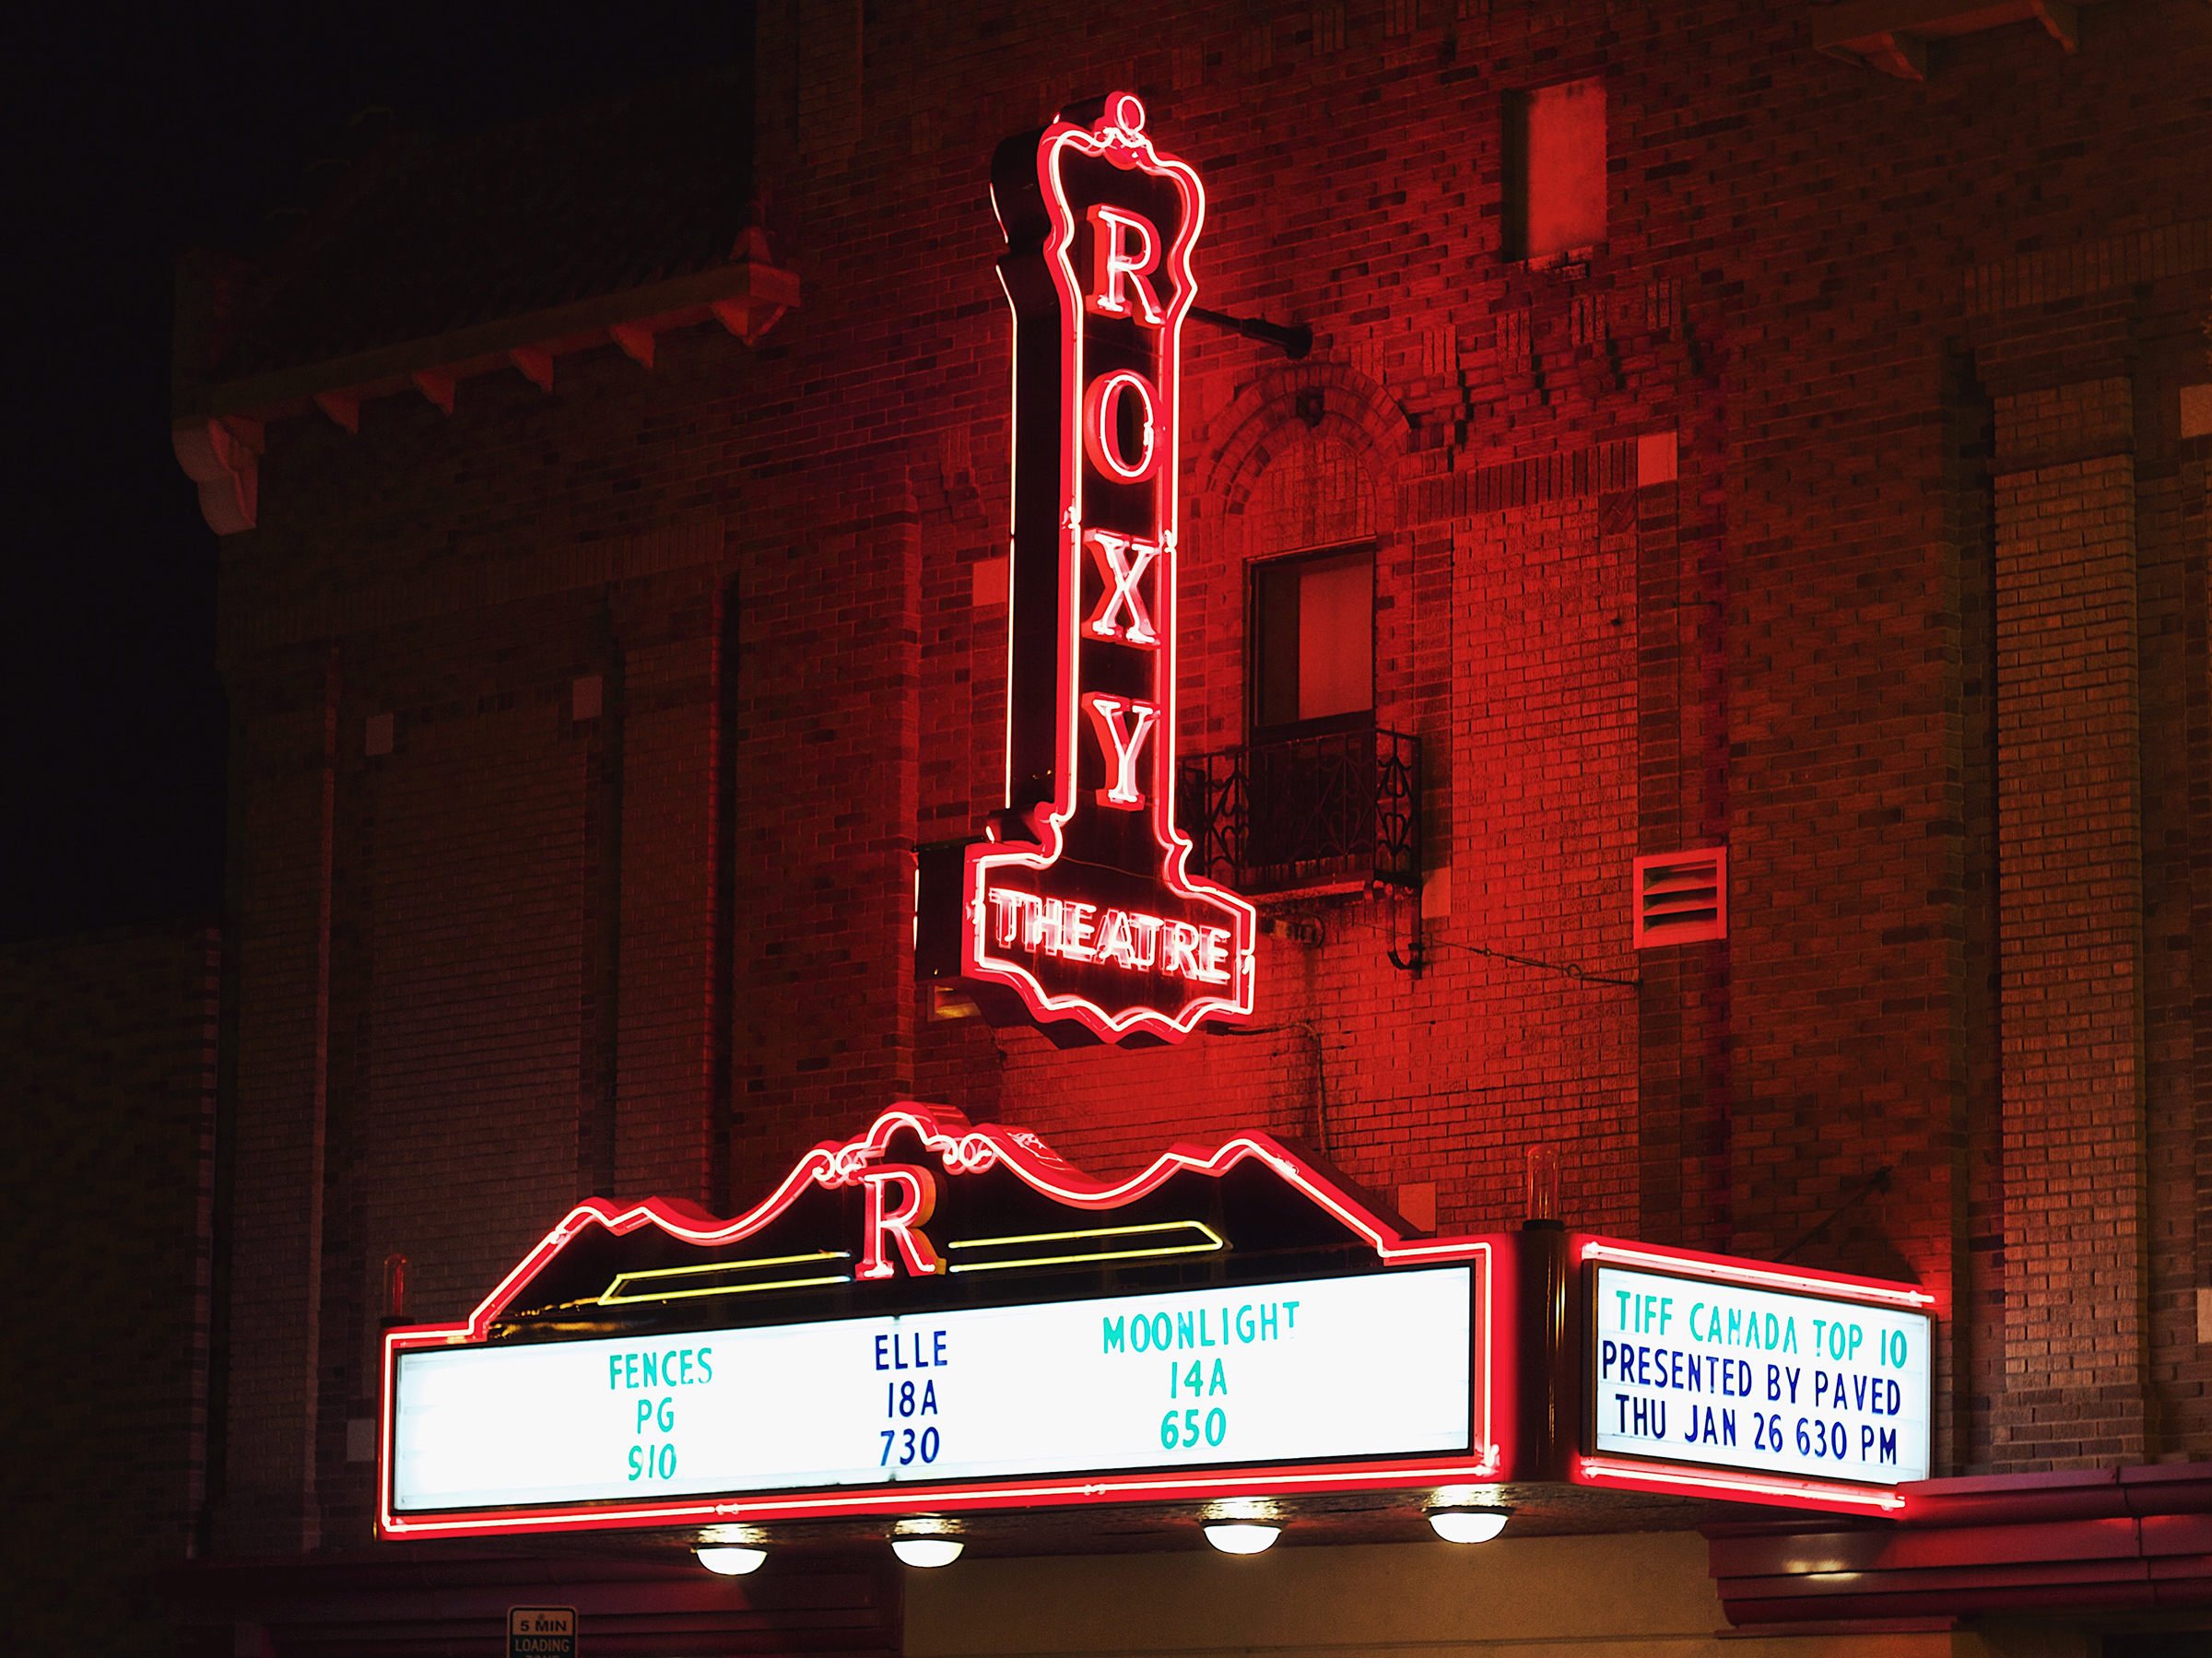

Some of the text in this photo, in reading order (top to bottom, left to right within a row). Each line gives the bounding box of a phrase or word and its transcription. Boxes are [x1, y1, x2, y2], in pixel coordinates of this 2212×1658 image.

[1081, 204, 1165, 812] ROXY
[989, 887, 1231, 985] THEATRE
[854, 1163, 947, 1281] R
[1102, 1300, 1300, 1355] MOONLIGHT
[1615, 1289, 1908, 1370] TIFF CANADA TOP 10
[609, 1346, 713, 1391] FENCES
[874, 1330, 948, 1371] ELLE
[888, 1379, 938, 1419] 18A
[1171, 1358, 1228, 1400] 14A
[1602, 1339, 1901, 1417] PRESENTED BY PAVED
[636, 1396, 675, 1435] PG
[1160, 1406, 1227, 1451] 650
[1615, 1393, 1897, 1466] THU JAN 26 630 PM
[879, 1426, 940, 1467] 730
[515, 1638, 571, 1653] LOADING
[520, 1620, 567, 1632] 5 MIN
